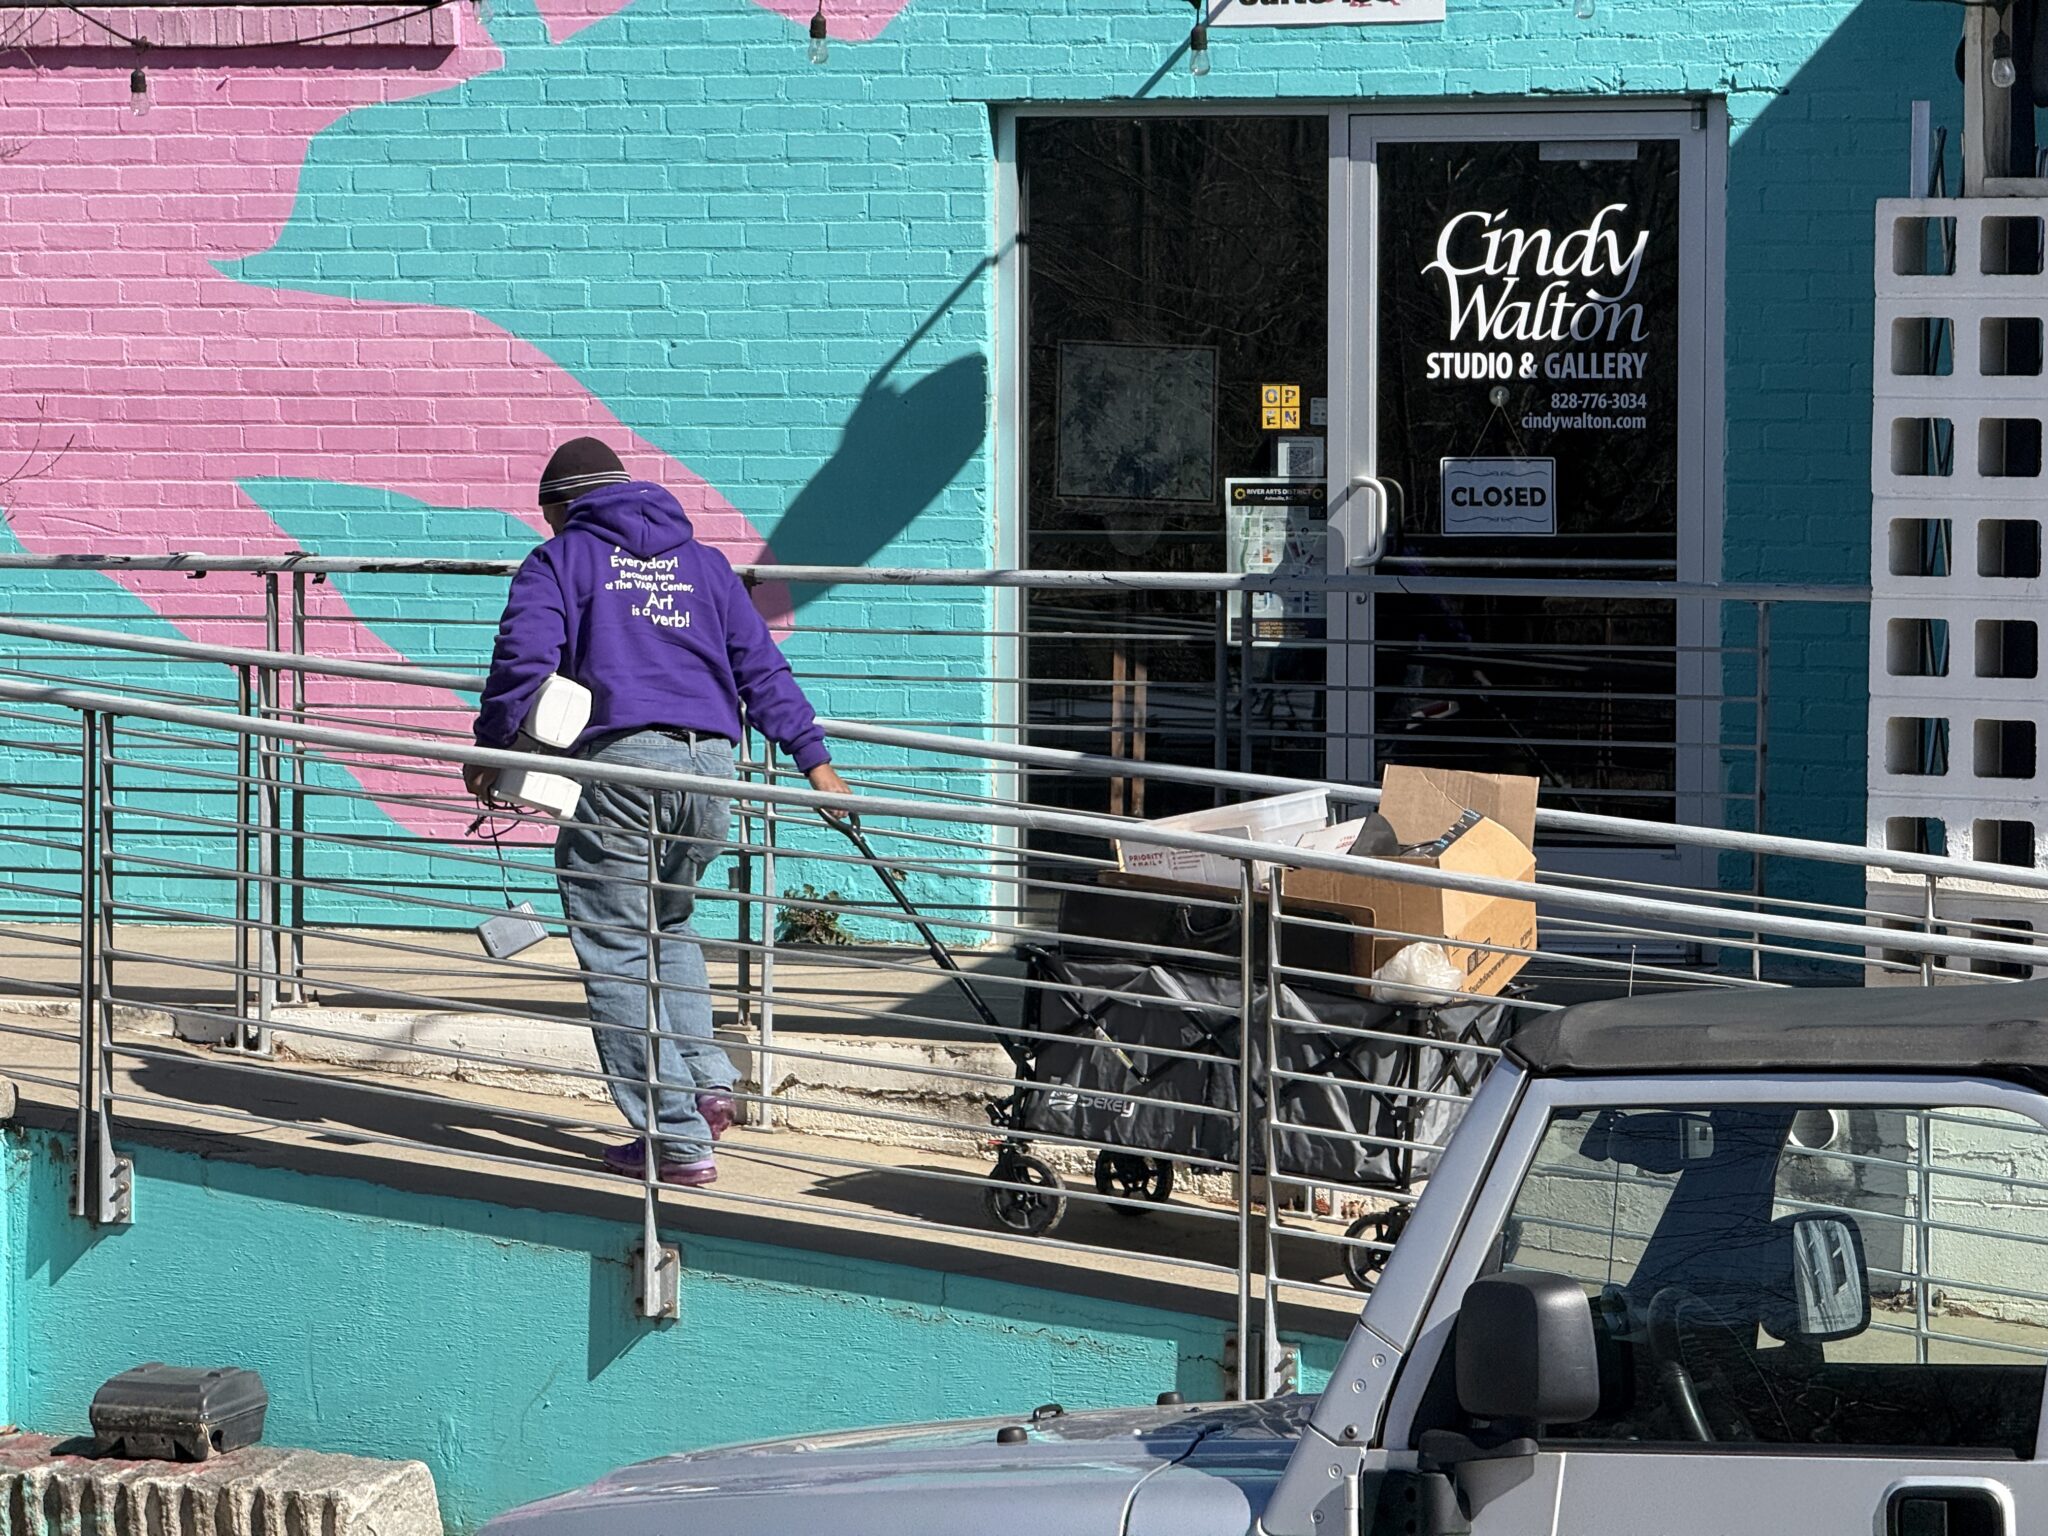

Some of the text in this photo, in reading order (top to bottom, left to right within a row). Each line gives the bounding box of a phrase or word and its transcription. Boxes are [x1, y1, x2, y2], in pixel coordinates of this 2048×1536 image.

[1437, 203, 1650, 301] Cindy
[1421, 262, 1650, 342] Walton
[1426, 352, 1648, 380] STUDIO & GALLERY
[1551, 393, 1647, 409] 828-776-3034
[1521, 412, 1647, 432] cindywalton.com
[1451, 486, 1547, 507] CLOSED
[610, 555, 679, 572] Everyday!
[620, 570, 675, 581] Because here
[605, 582, 613, 590] at
[614, 580, 632, 590] The
[661, 582, 694, 593] Center,
[631, 604, 651, 616] is a
[646, 592, 674, 610] Art
[651, 610, 690, 628] verb!
[1128, 852, 1164, 862] PRIORITY
